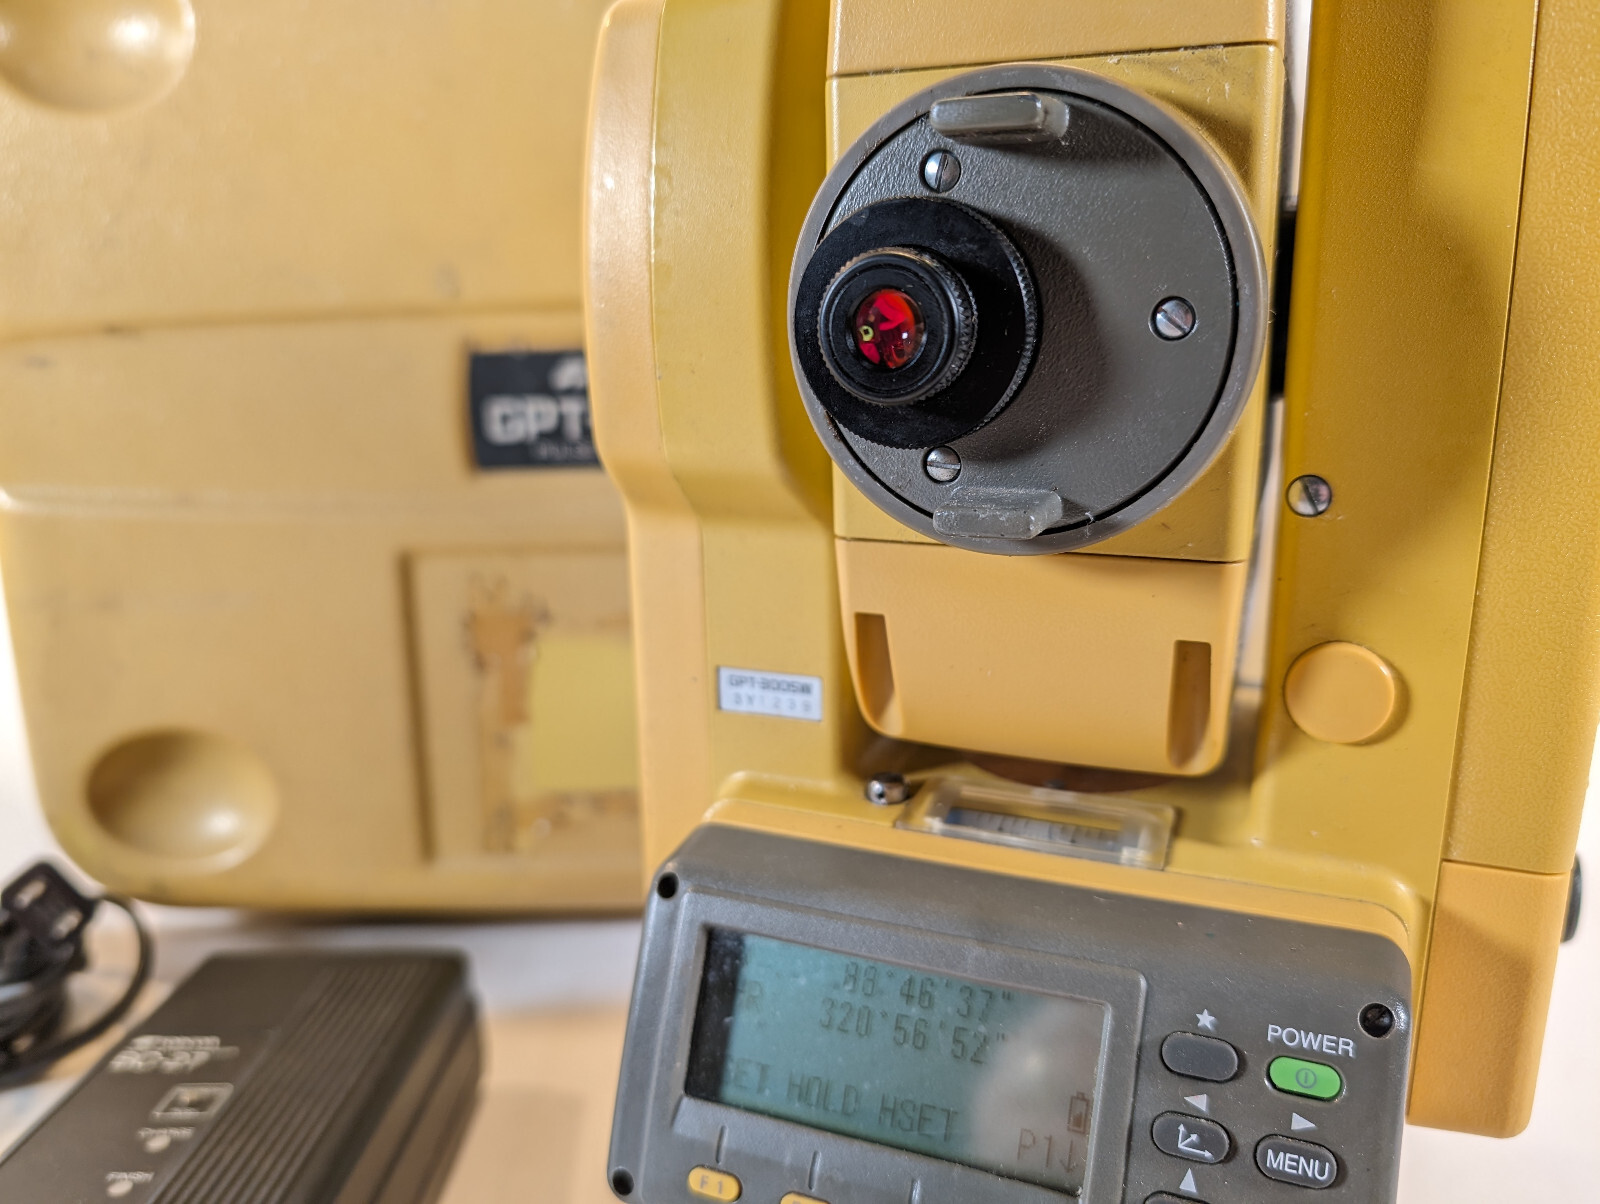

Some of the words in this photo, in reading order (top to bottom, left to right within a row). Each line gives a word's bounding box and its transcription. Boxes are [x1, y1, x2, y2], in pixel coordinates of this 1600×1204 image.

[1266, 1023, 1356, 1058] POWER
[787, 1073, 861, 1118] HOLD
[878, 1097, 960, 1142] HSET
[1266, 1148, 1330, 1181] MENU
